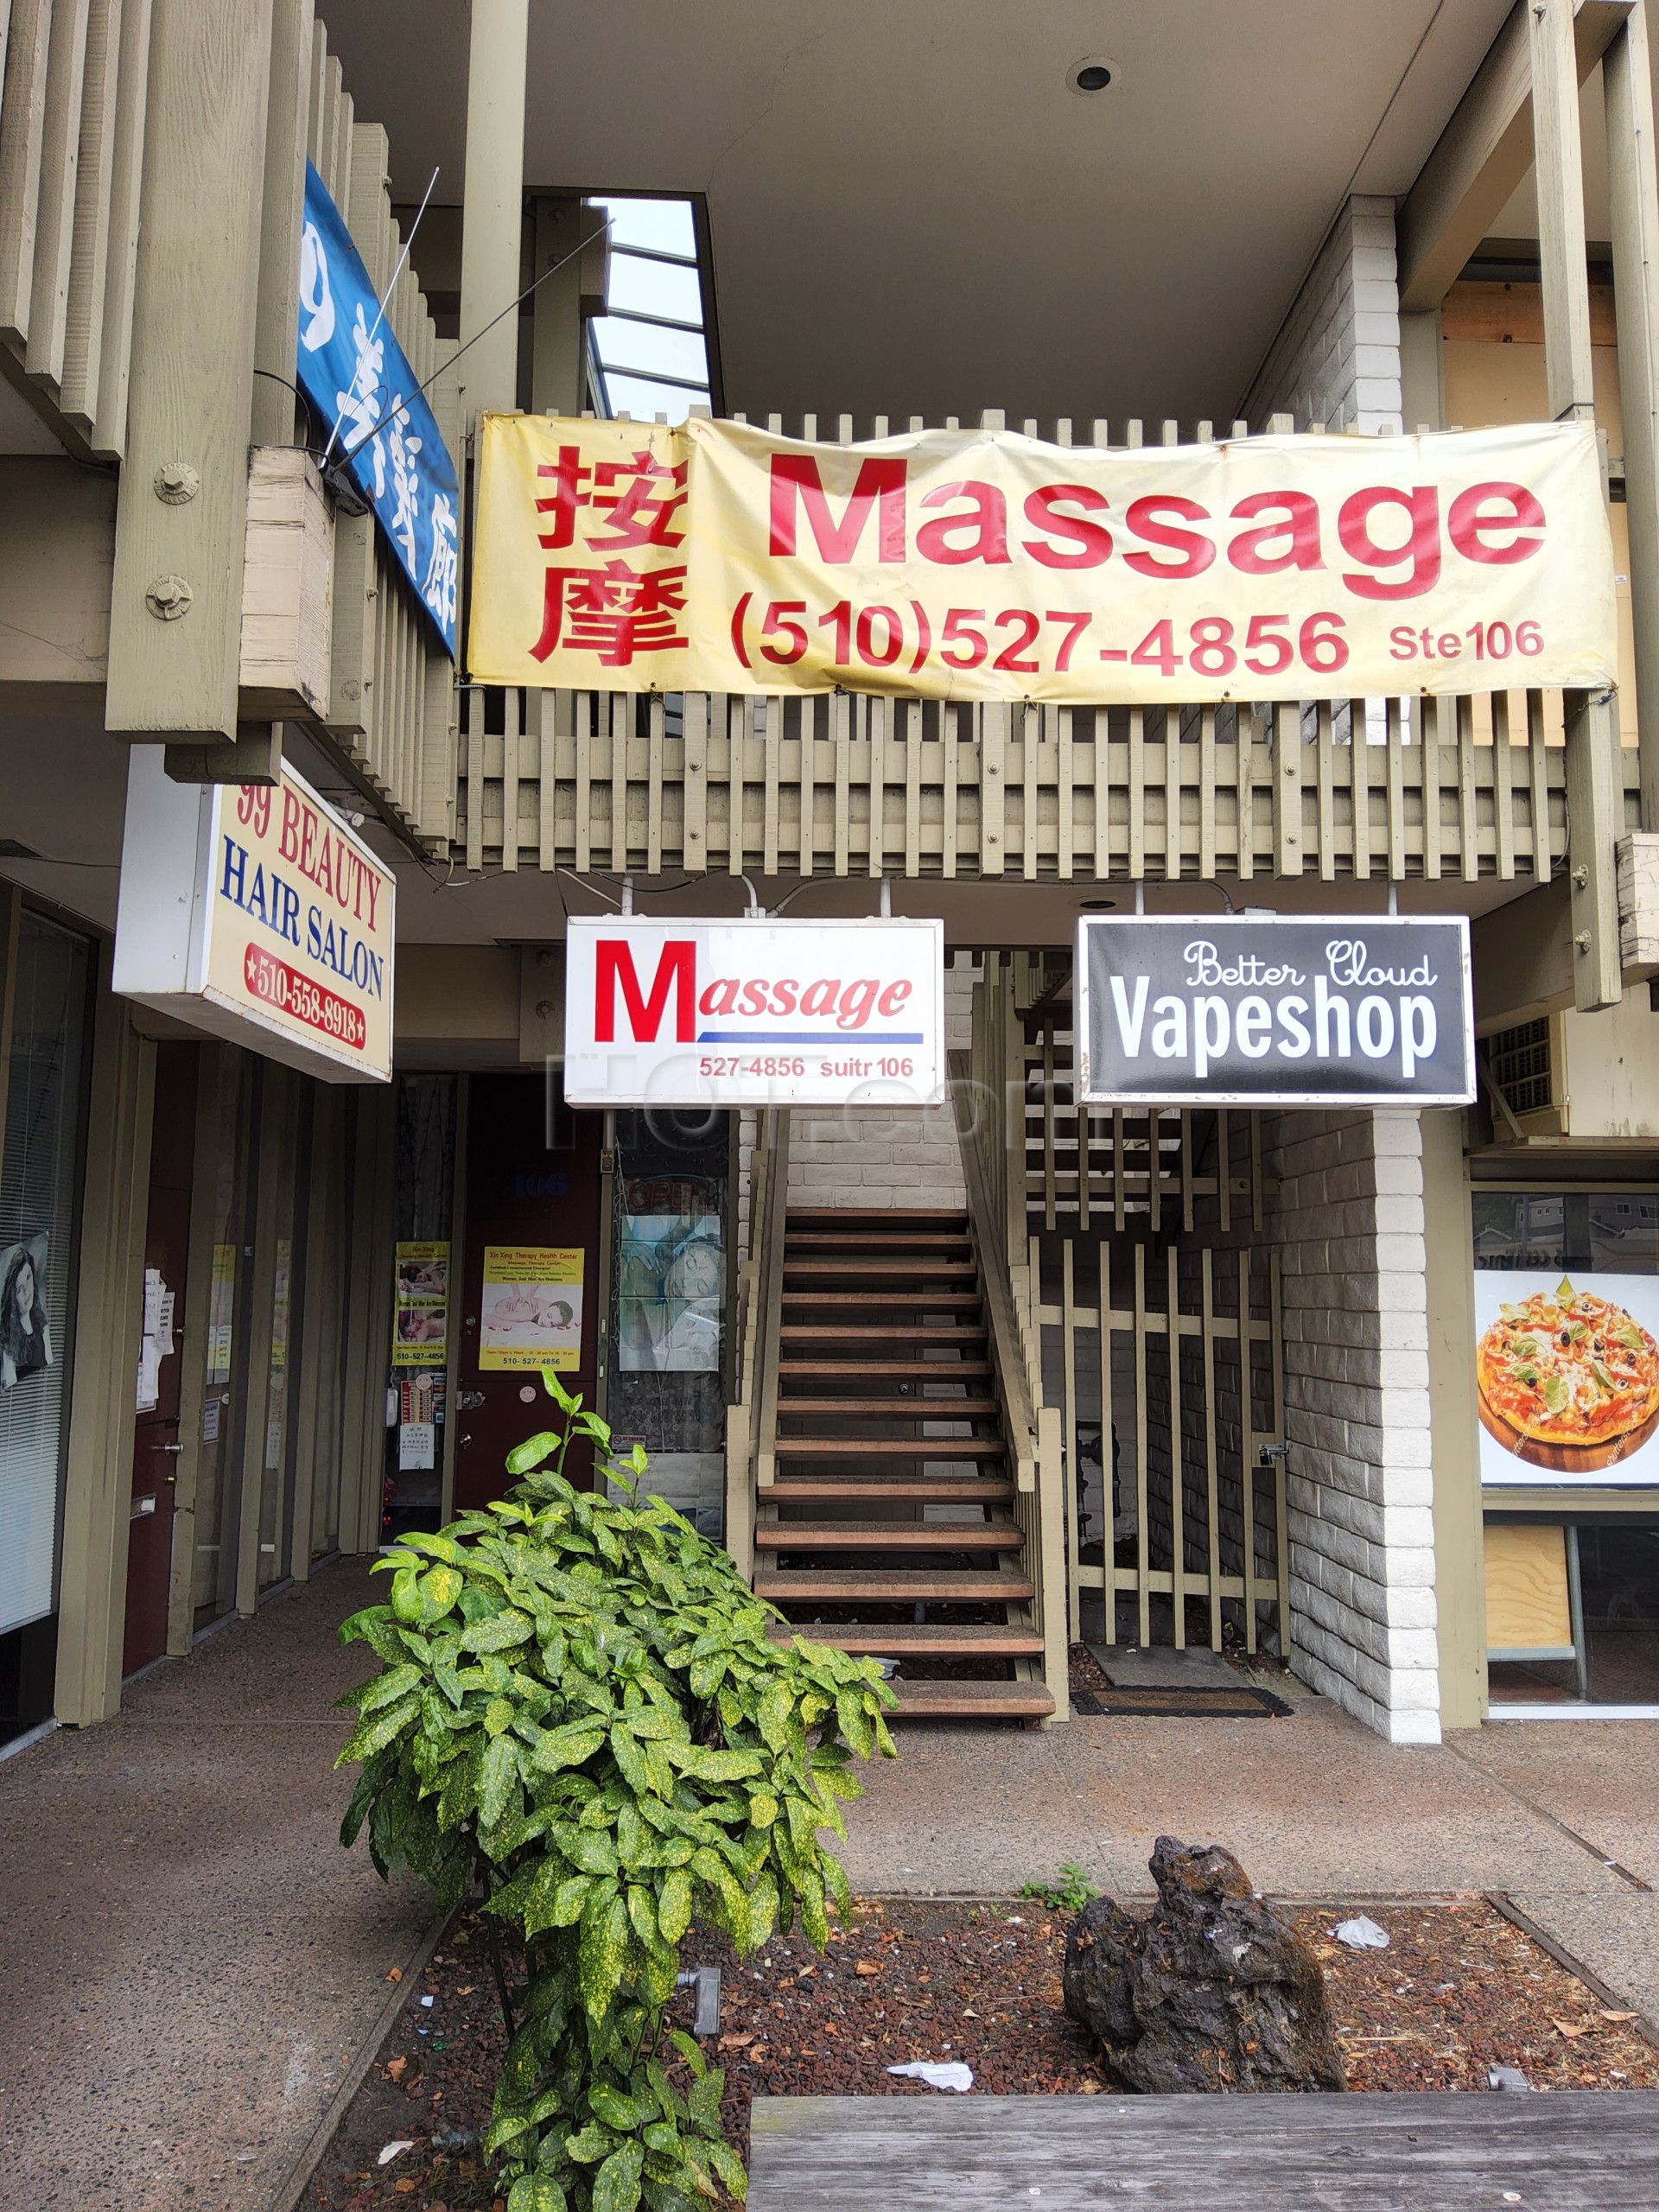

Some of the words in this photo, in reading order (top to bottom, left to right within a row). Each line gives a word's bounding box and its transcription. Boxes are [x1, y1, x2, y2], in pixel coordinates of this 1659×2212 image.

[528, 445, 690, 666] 按摩
[768, 453, 1547, 601] Massage
[731, 591, 1351, 677] (510)527-4856
[278, 783, 382, 932] BEAUTY
[219, 834, 301, 947] HAIR
[307, 905, 385, 1002] SALON
[1183, 939, 1306, 988] Better
[1325, 939, 1439, 988] Cloud
[257, 955, 357, 1043] 510-558-8918
[594, 938, 913, 1044] Massage
[1109, 975, 1438, 1078] Vapeshop
[698, 1056, 805, 1077] 527-4856
[820, 1056, 873, 1077] suitr
[878, 1057, 914, 1077] 106
